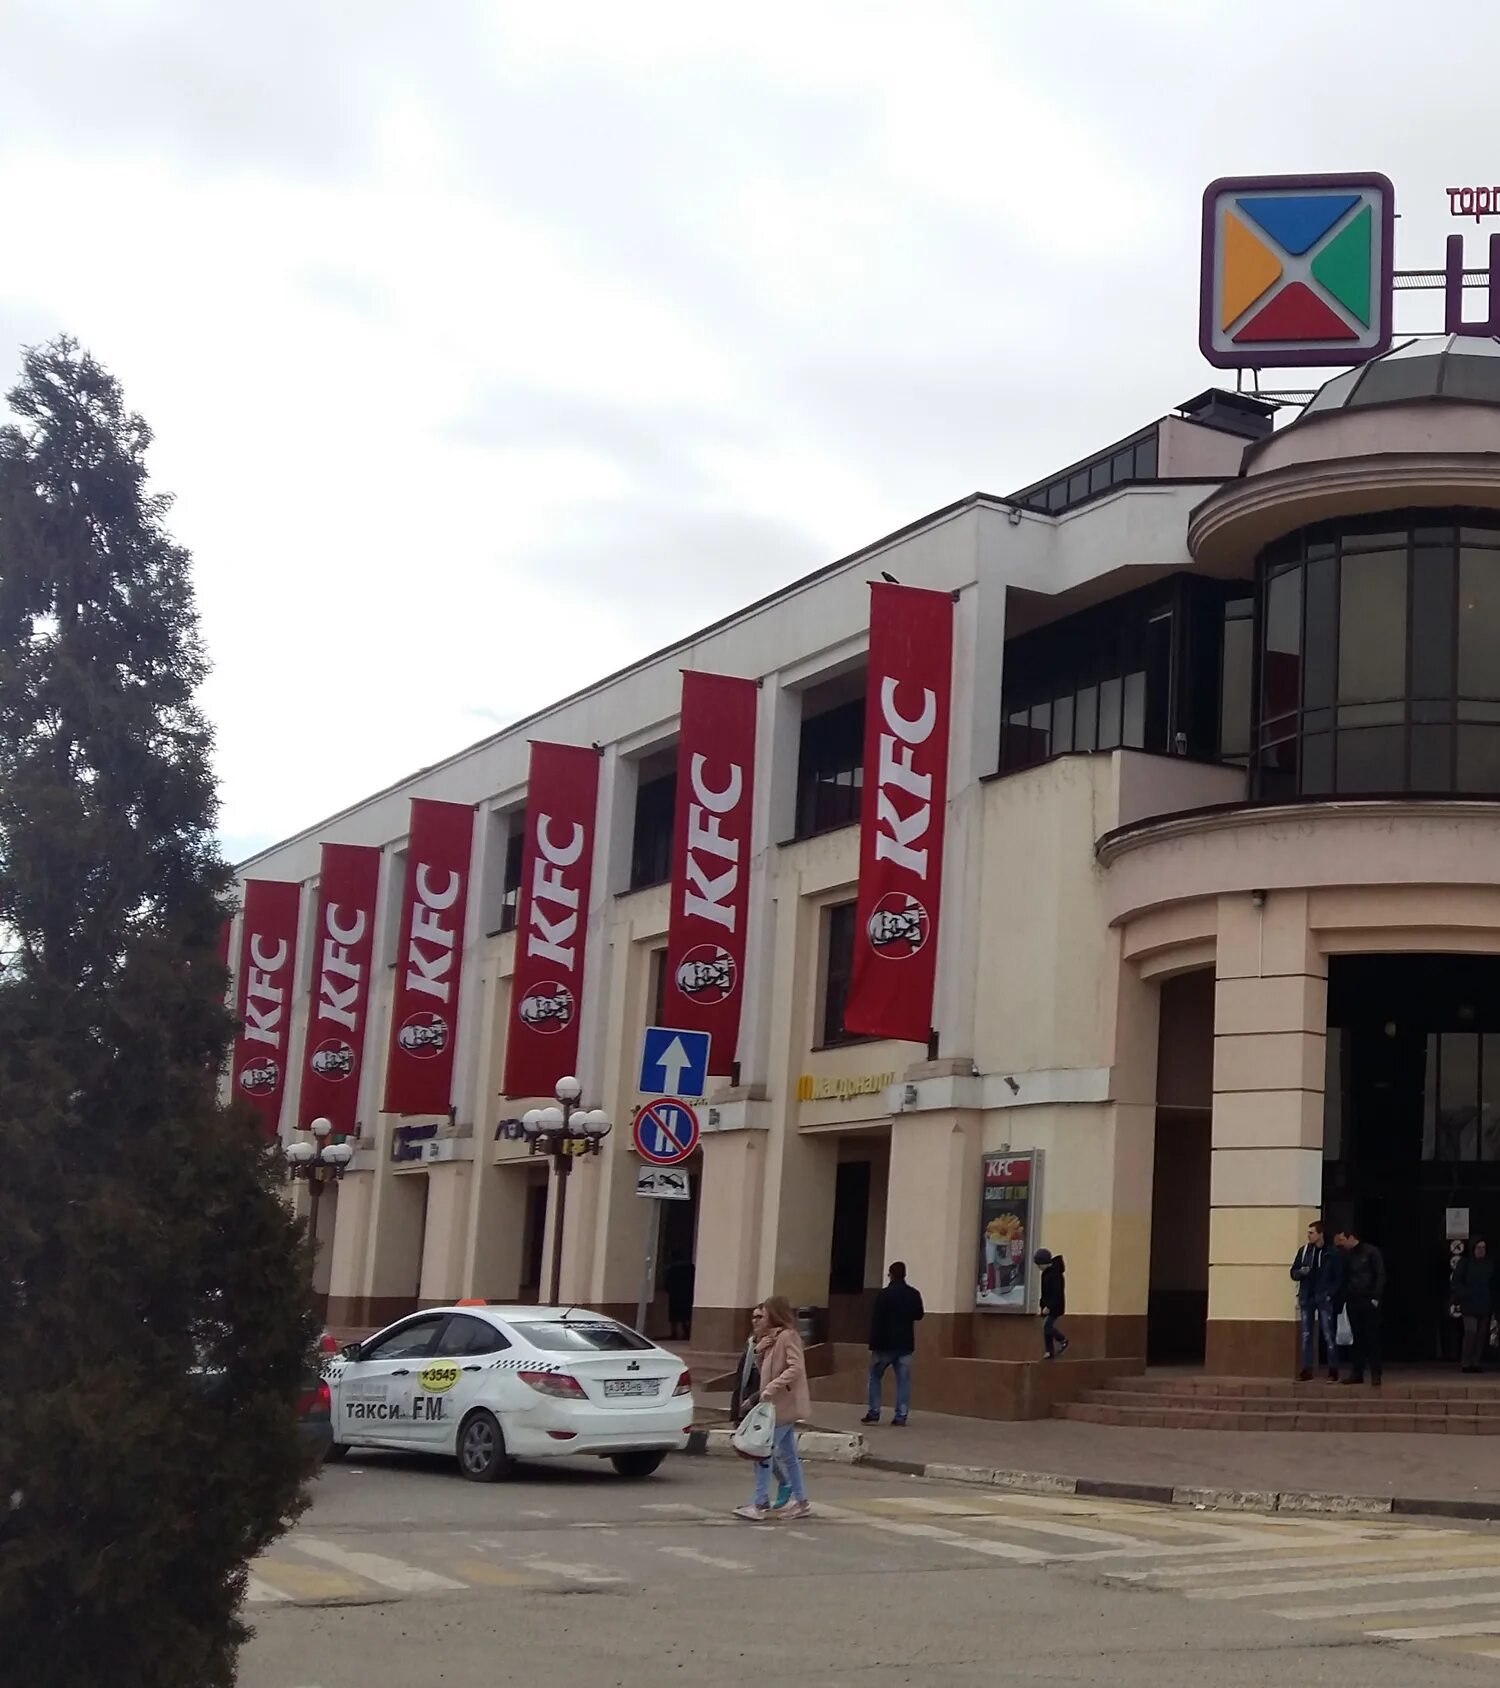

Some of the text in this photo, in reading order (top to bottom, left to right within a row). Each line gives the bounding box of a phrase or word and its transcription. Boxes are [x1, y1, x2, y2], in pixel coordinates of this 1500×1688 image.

[684, 752, 742, 933] KFC
[876, 676, 936, 880] KFC
[406, 862, 459, 1003] KFC
[528, 813, 584, 971] KFC
[244, 933, 287, 1049] KFC
[318, 903, 366, 1032] KFC
[987, 1160, 1013, 1177] KFC
[346, 1396, 443, 1420] такси FM
